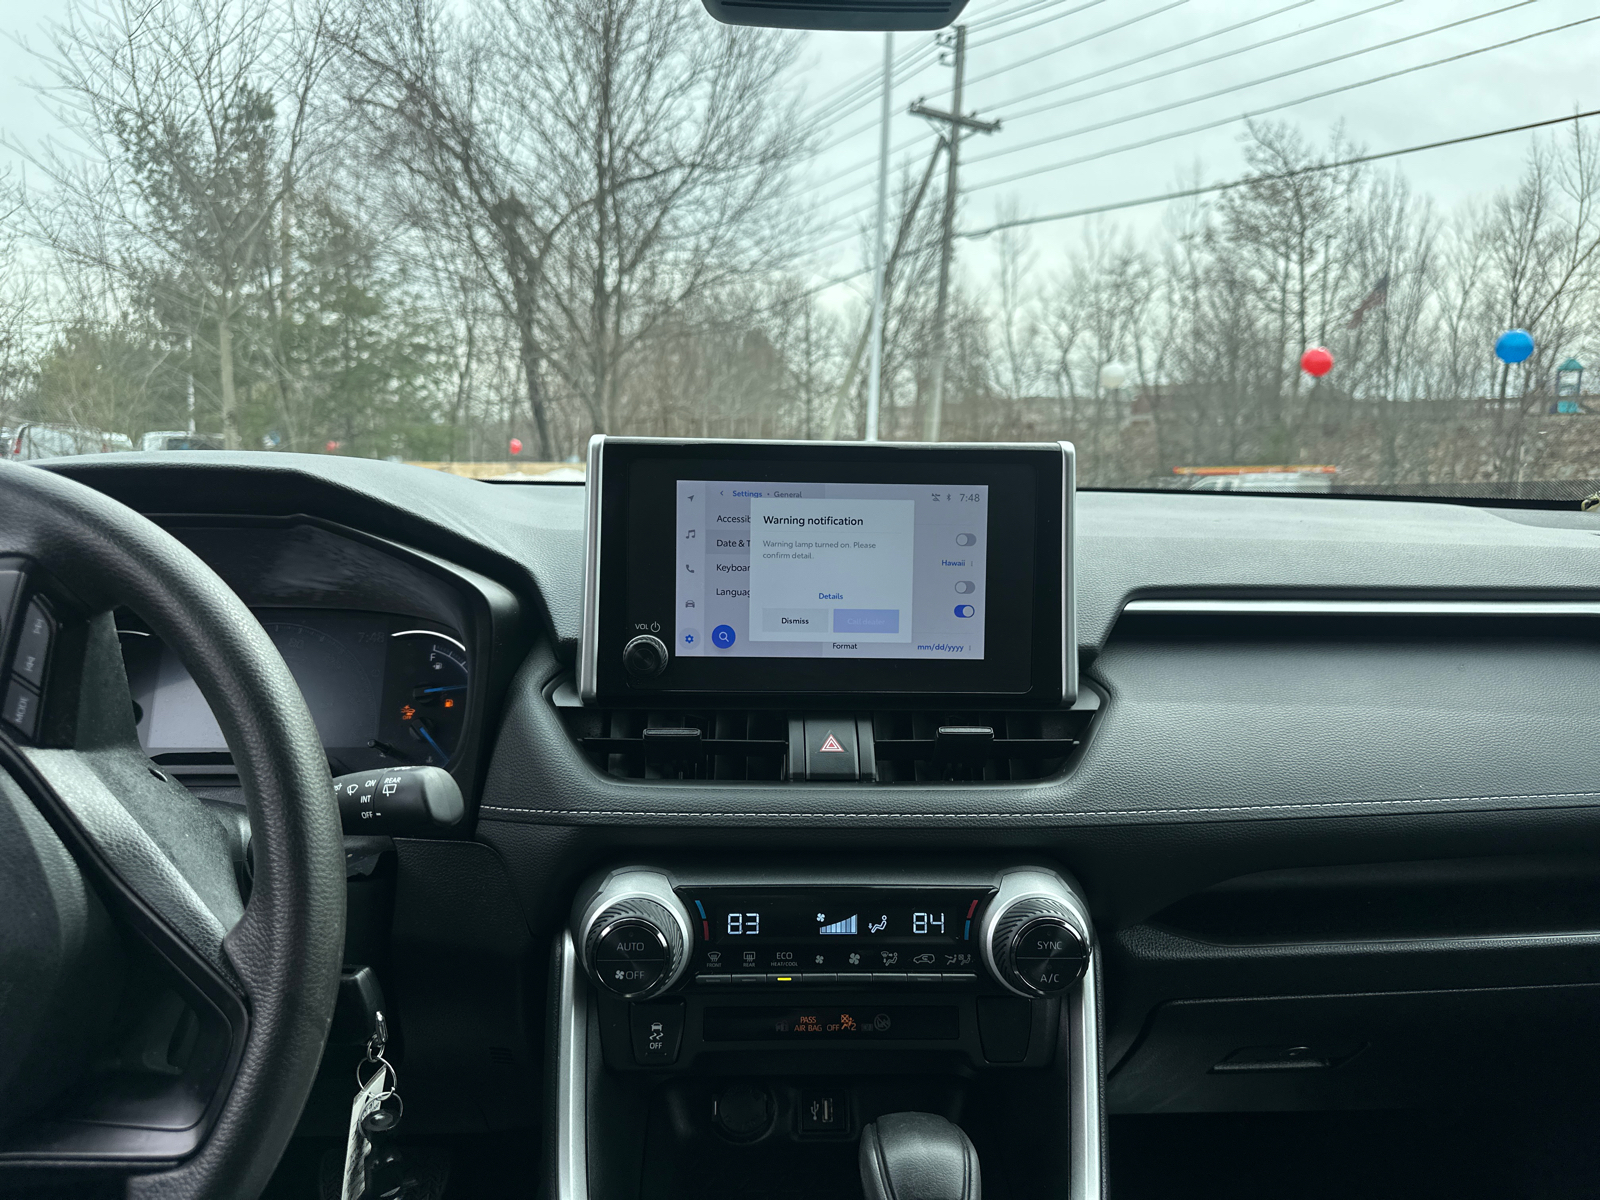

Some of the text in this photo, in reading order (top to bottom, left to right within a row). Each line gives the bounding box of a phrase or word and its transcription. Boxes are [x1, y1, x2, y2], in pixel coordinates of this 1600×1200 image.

[732, 490, 803, 499] Settings General
[959, 493, 980, 502] 7:48
[763, 515, 864, 527] Warning notification
[716, 539, 737, 548] Date
[738, 539, 745, 548] &
[762, 540, 793, 549] Warning
[794, 540, 813, 549] lamp
[815, 541, 839, 549] turned
[853, 541, 877, 549] Please
[762, 551, 791, 559] confirm
[941, 559, 966, 567] Hawaii
[818, 592, 844, 600] Details
[781, 617, 810, 625] Dismiss
[832, 642, 858, 650] Format
[917, 643, 964, 652] mm/dd/yyyy
[429, 653, 436, 661] F
[364, 779, 377, 788] ON
[360, 795, 372, 803] INT
[361, 811, 373, 819] OFF
[727, 912, 760, 935] 83
[912, 912, 945, 935] 84
[616, 942, 645, 951] AUTO
[1037, 940, 1062, 950] SYNC
[776, 951, 793, 960] ECO
[625, 970, 645, 980] OFF
[1040, 973, 1059, 983] A/C
[800, 1016, 817, 1024] PASS
[793, 1024, 806, 1032] AIR
[807, 1024, 823, 1032] BAG
[649, 1042, 663, 1050] OFF
